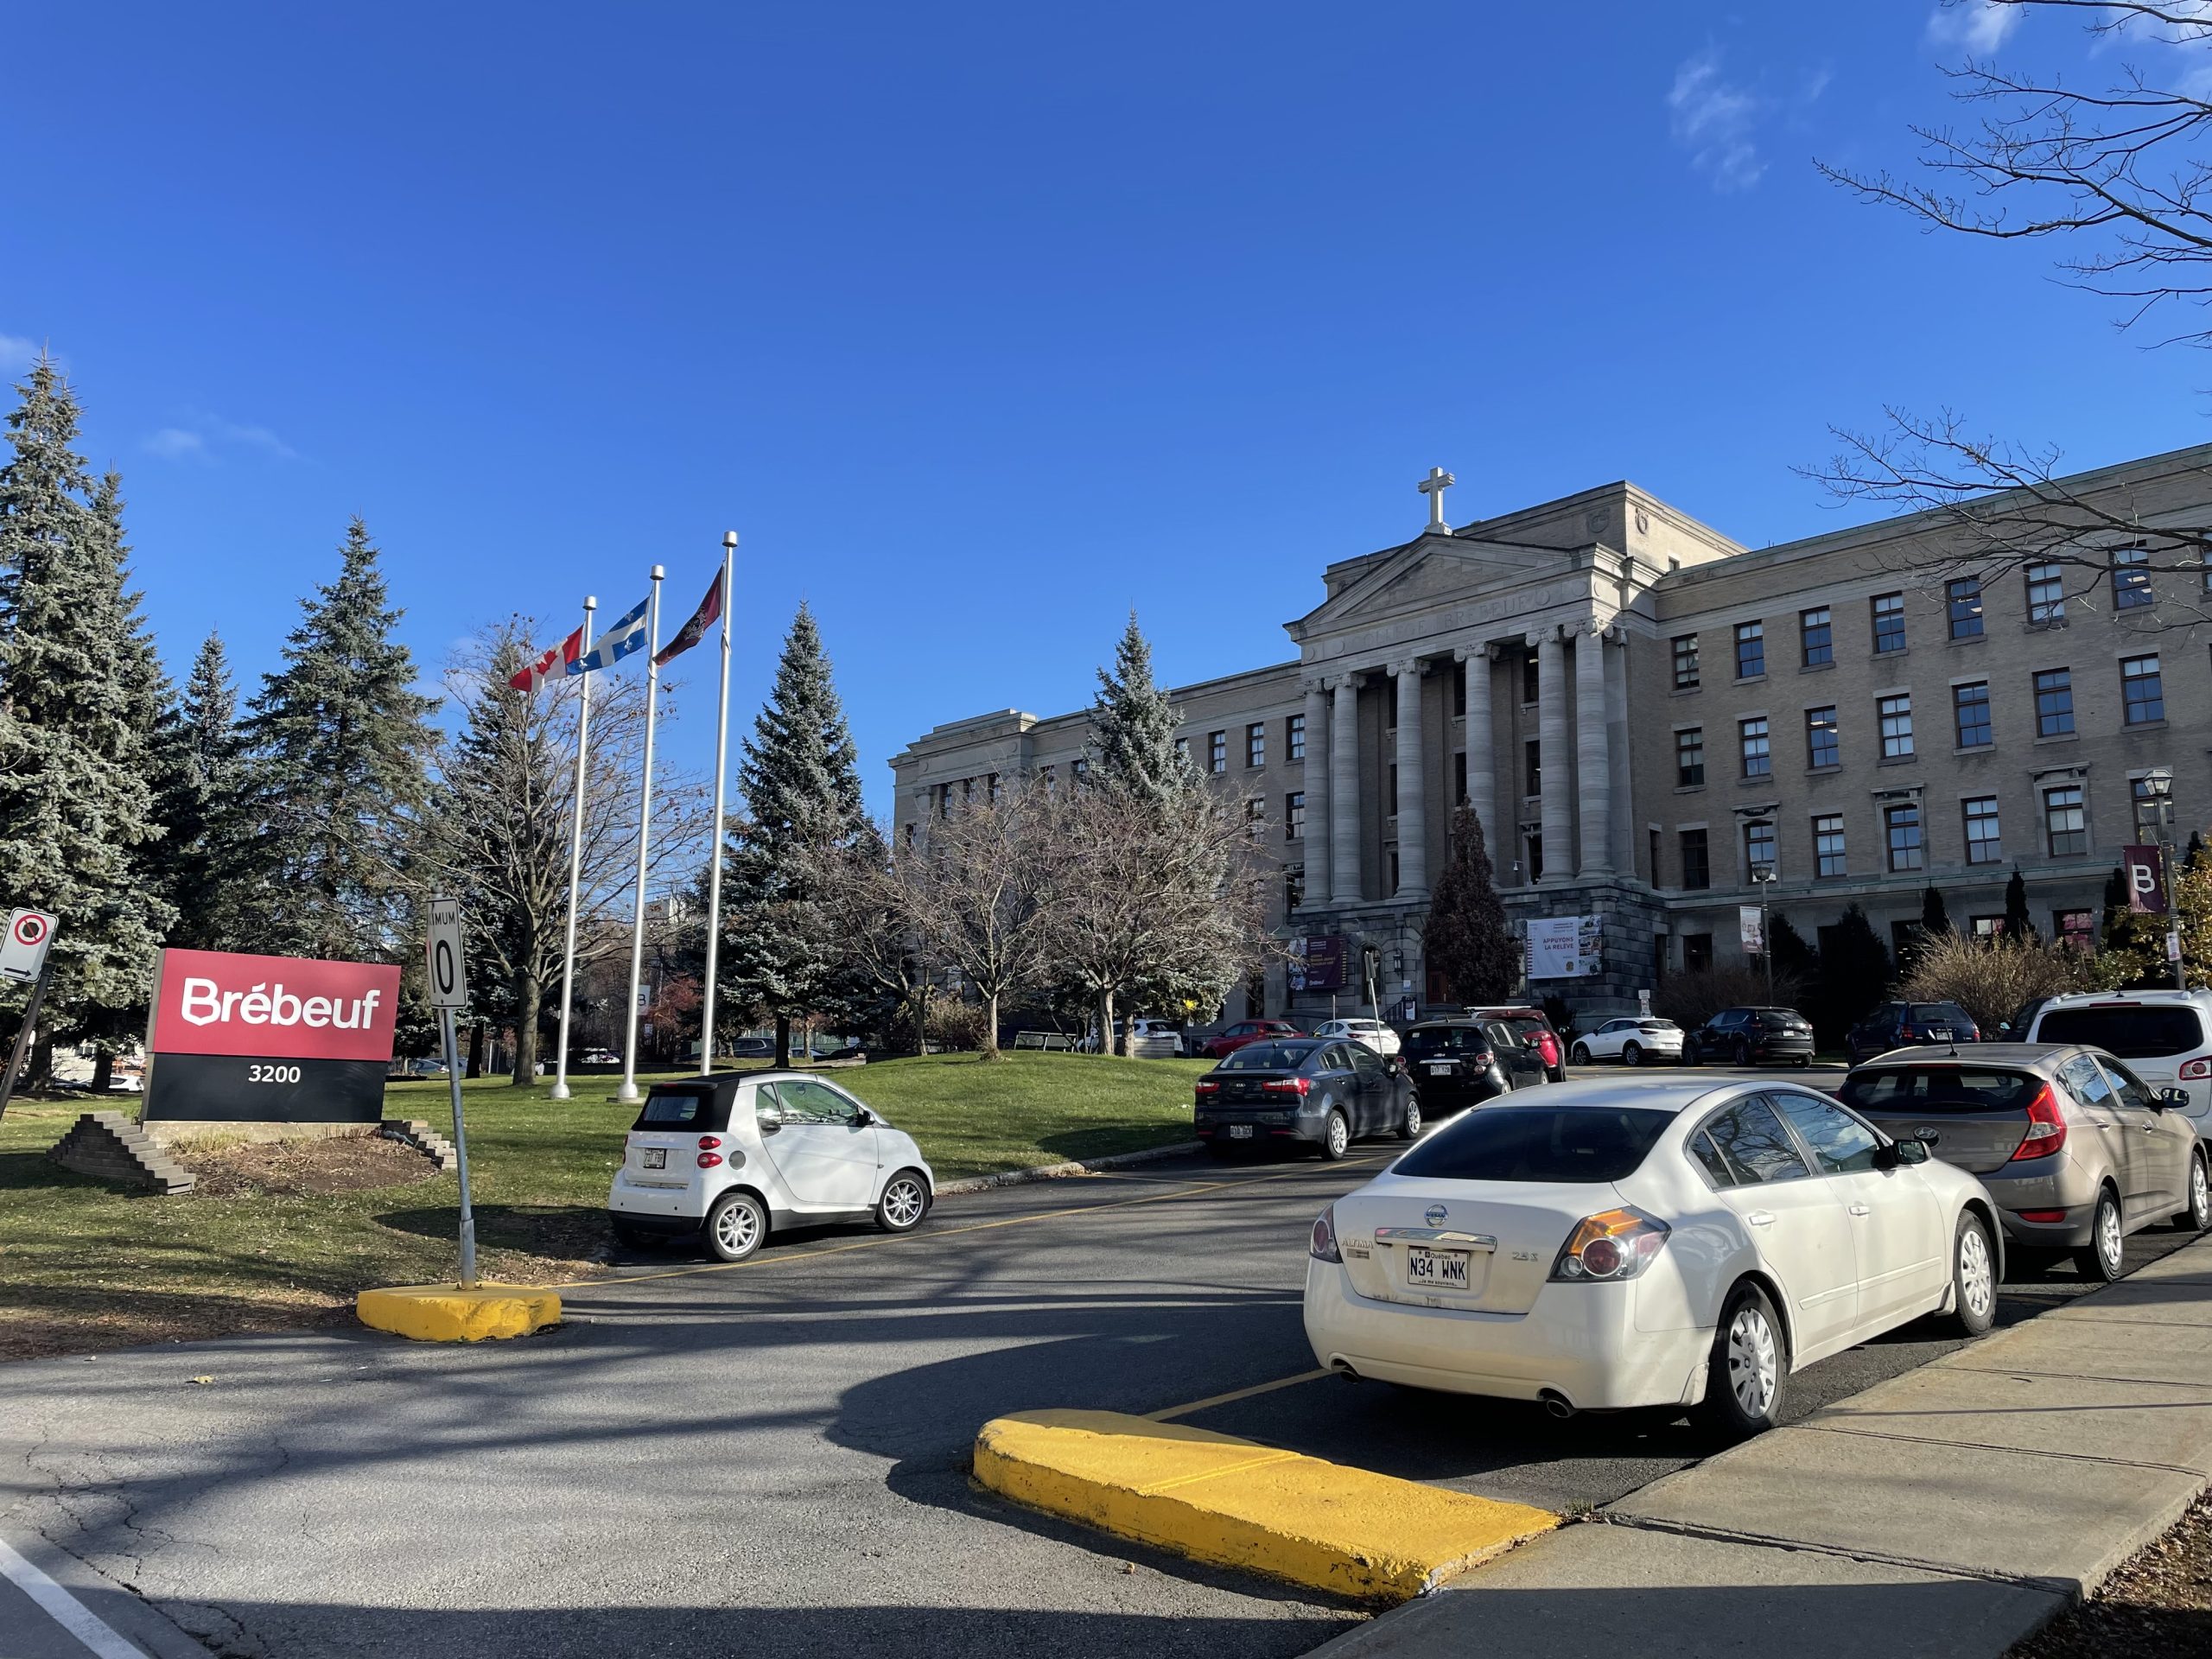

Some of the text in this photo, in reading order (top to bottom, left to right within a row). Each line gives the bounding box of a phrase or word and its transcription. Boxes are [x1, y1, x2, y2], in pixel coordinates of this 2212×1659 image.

[2132, 864, 2155, 893] B
[181, 977, 380, 1029] Brébeuf
[248, 1065, 301, 1083] 3200
[1342, 1238, 1374, 1249] ALTIMA
[1410, 1257, 1465, 1280] N34 WNK
